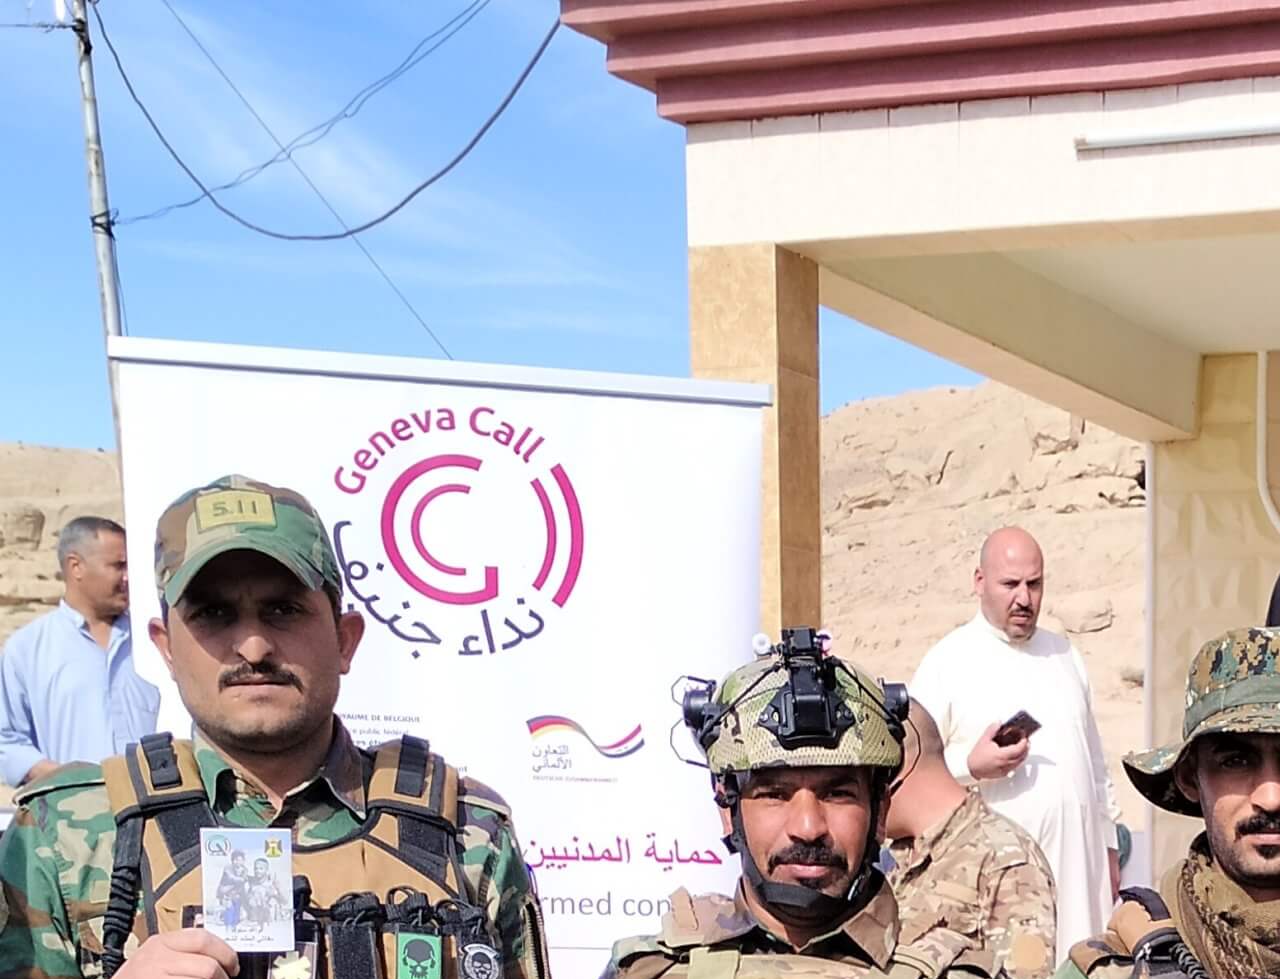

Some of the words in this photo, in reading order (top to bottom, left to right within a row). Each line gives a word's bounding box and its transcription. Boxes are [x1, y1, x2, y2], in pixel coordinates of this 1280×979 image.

[334, 407, 455, 494] Geneva
[469, 407, 545, 463] Call
[213, 500, 258, 517] 5.11
[333, 521, 442, 659] جنيف
[458, 598, 544, 656] نداء
[523, 835, 631, 868] المدنيين
[644, 833, 722, 871] حماية
[543, 891, 612, 915] med
[622, 898, 671, 916] con
